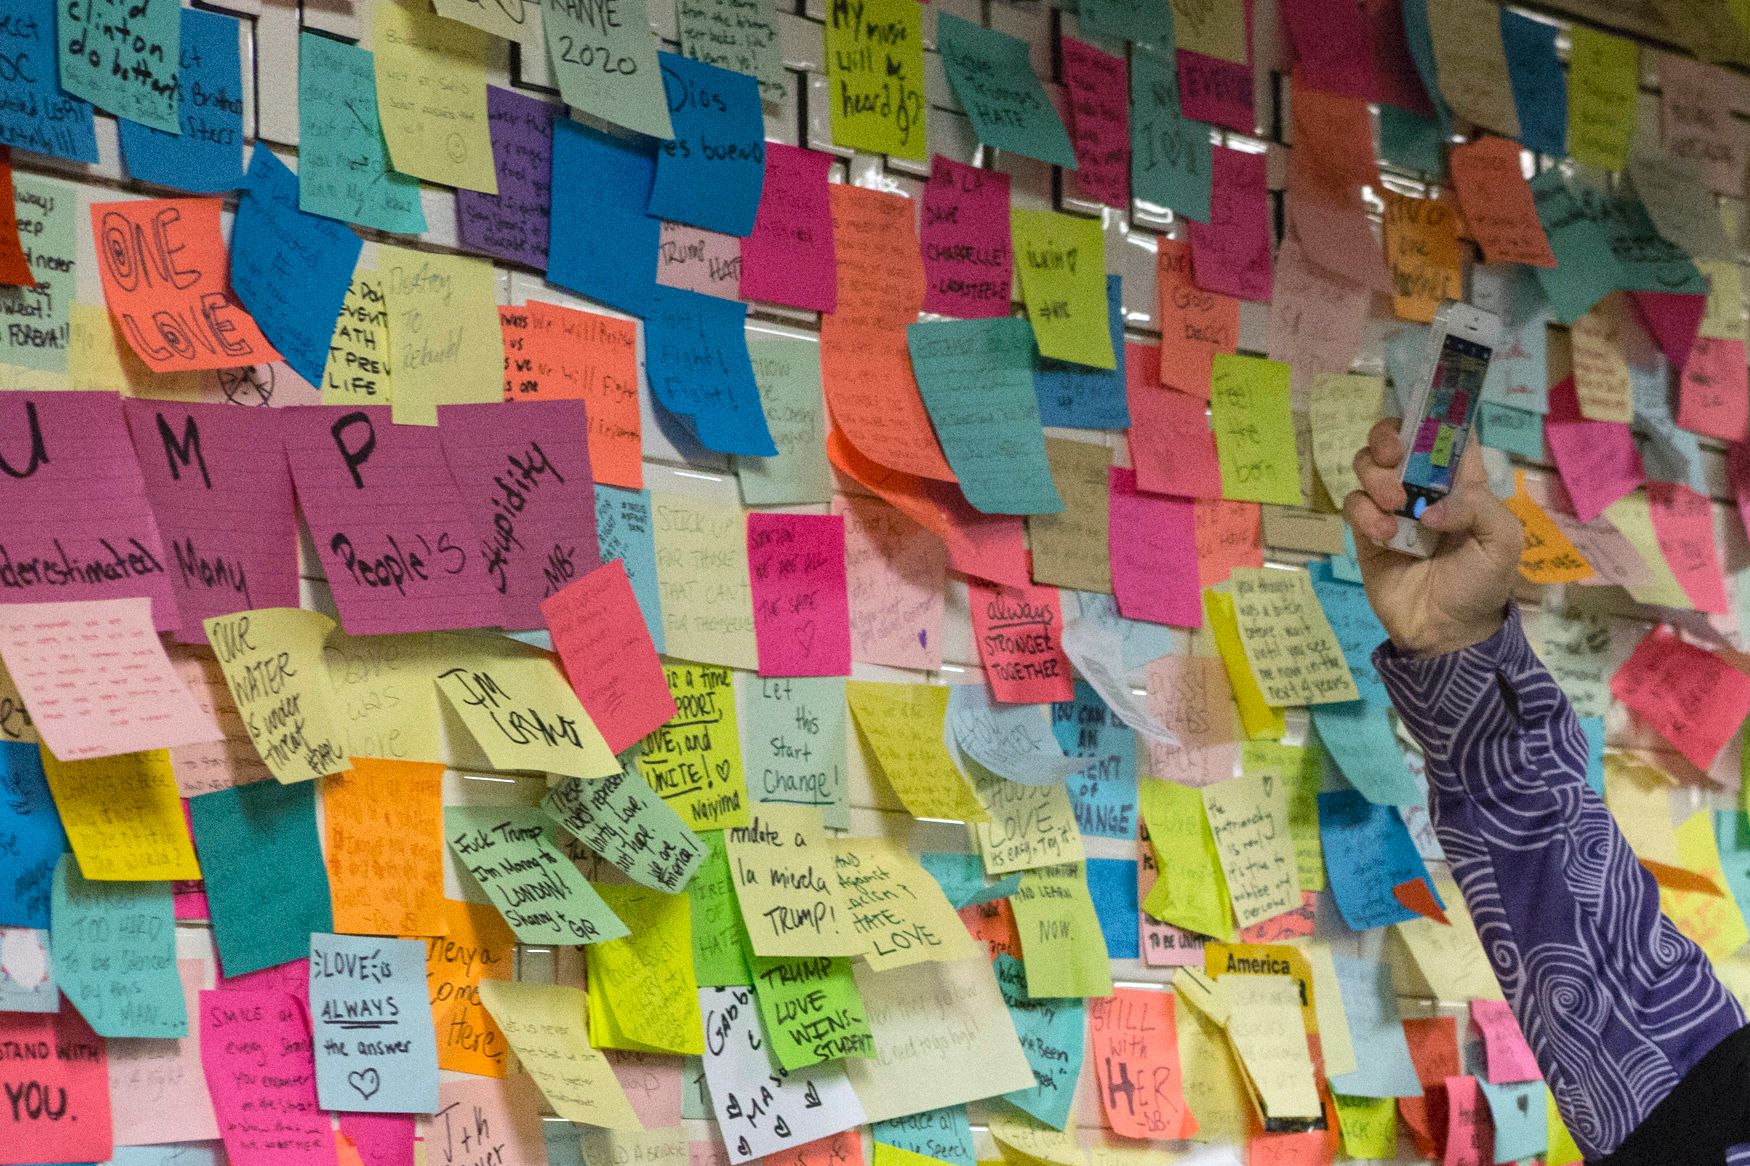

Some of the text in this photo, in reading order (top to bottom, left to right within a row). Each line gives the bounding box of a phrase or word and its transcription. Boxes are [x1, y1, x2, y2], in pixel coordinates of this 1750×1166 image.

[560, 36, 638, 75] 2020
[102, 207, 202, 292] ONE
[122, 292, 253, 362] LOVE
[328, 375, 378, 396] LIFE
[330, 411, 378, 489] P
[172, 537, 254, 610] Many
[330, 531, 466, 597] People's
[213, 616, 257, 663] OUR
[984, 627, 1055, 656] STRONGER
[230, 652, 298, 707] WATER
[702, 665, 732, 688] time
[762, 677, 793, 700] Let
[990, 660, 1061, 684] TOGETHER
[796, 706, 820, 735] this
[688, 726, 713, 753] and
[772, 737, 813, 761] Start
[764, 763, 843, 803] Change!
[1073, 803, 1134, 835] HANGE
[454, 821, 543, 856] Fuck Trump
[793, 831, 807, 847] a
[496, 870, 573, 907] LONDON!
[763, 904, 839, 938] TRUMP!
[872, 923, 943, 957] LOVE
[320, 950, 393, 979] LOVE is
[760, 957, 832, 989] TRUMP
[1226, 953, 1291, 976] America
[320, 996, 400, 1021] ALWAYS
[774, 989, 829, 1026] LOVE
[1091, 1000, 1157, 1034] STILL
[322, 1038, 413, 1057] the answer
[5, 1080, 79, 1122] YOU.
[1105, 1056, 1180, 1118] HER
